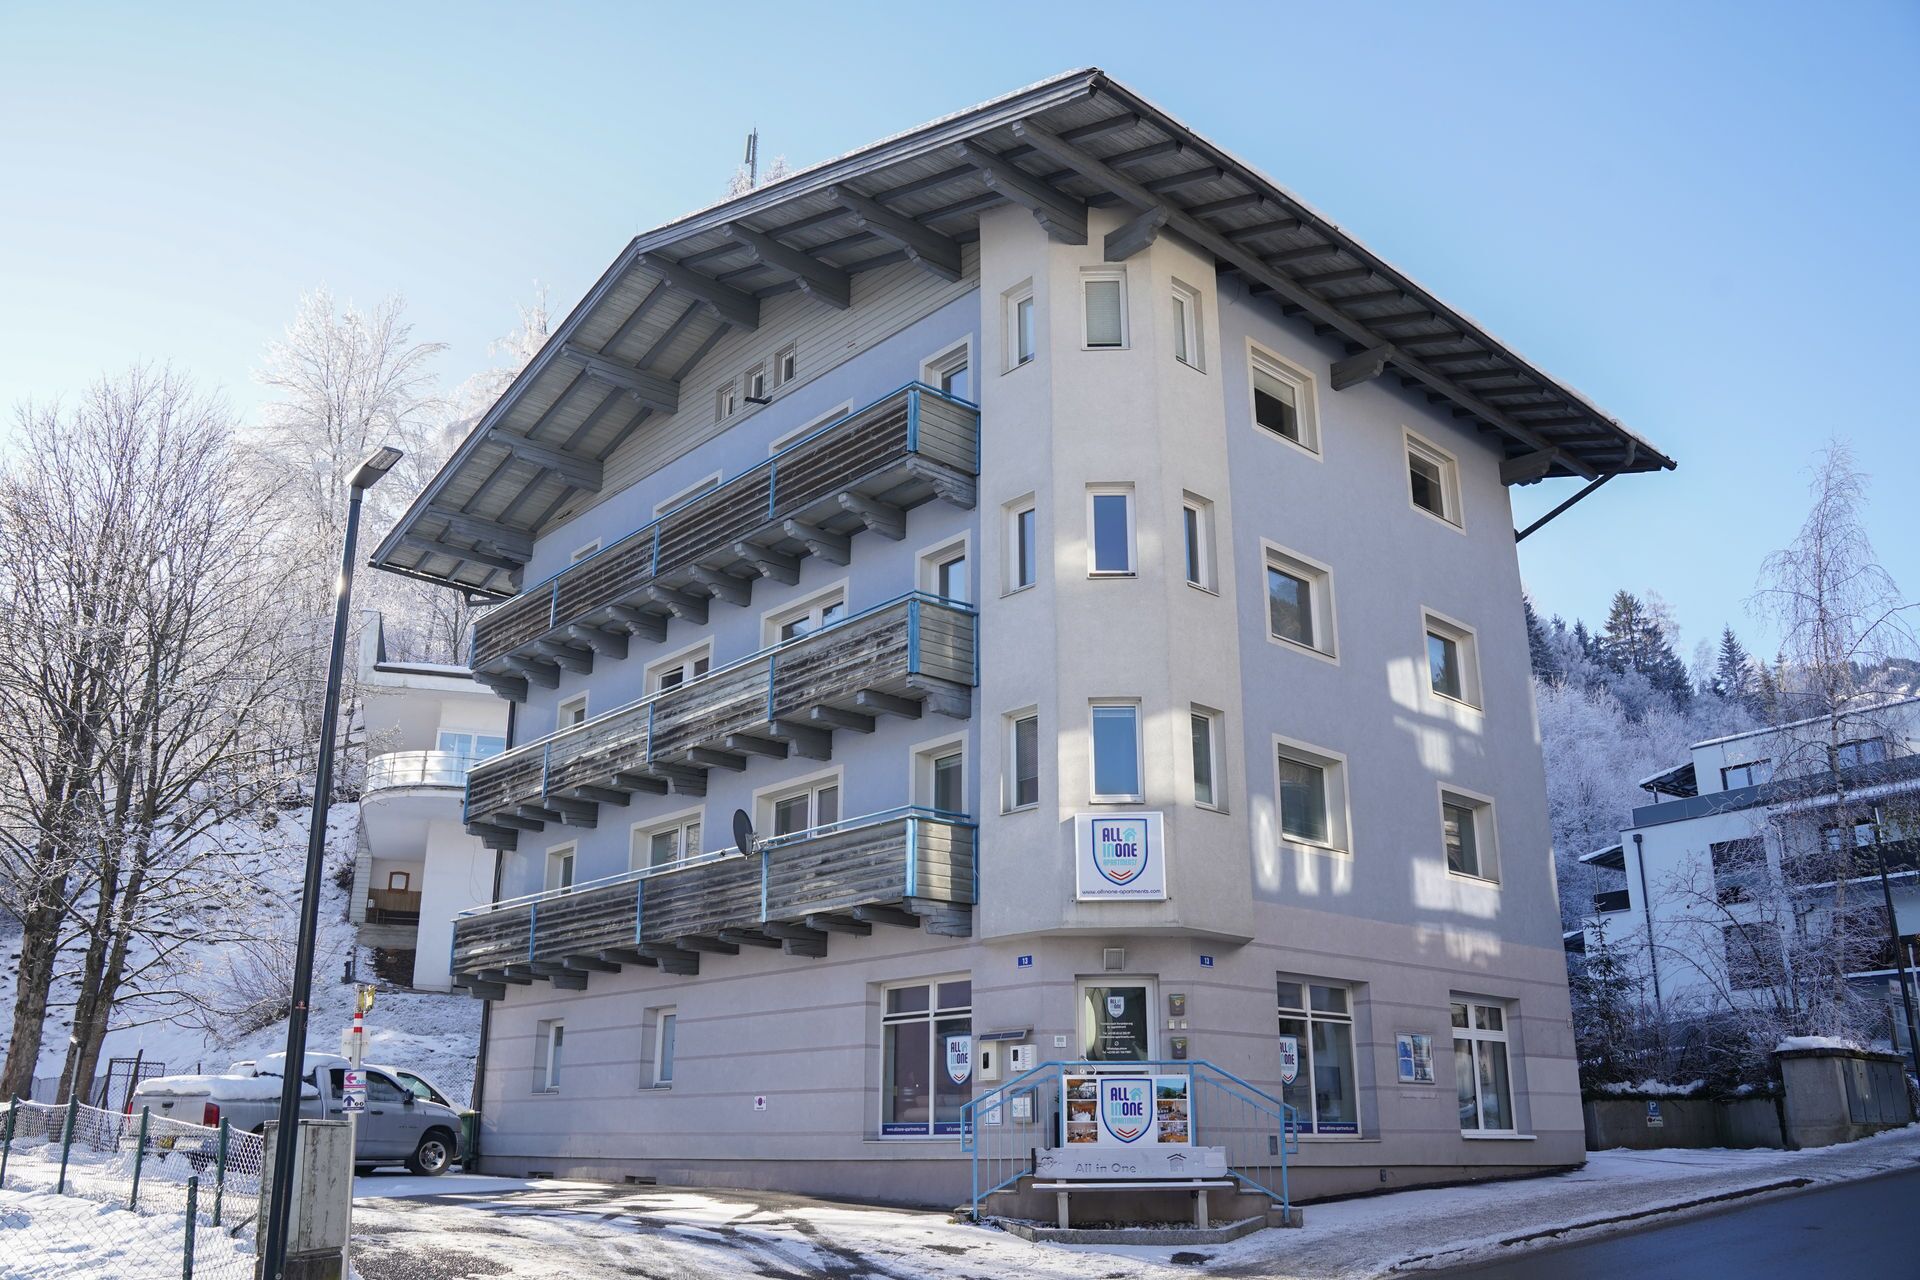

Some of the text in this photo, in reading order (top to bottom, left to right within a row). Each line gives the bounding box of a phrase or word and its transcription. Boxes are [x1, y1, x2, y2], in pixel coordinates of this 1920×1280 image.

[1102, 827, 1122, 842] ALL
[1022, 957, 1029, 965] 13
[950, 1041, 961, 1053] ALL
[1110, 1087, 1129, 1101] ALL
[1650, 1101, 1657, 1110] P
[1075, 1162, 1137, 1173] All in One
